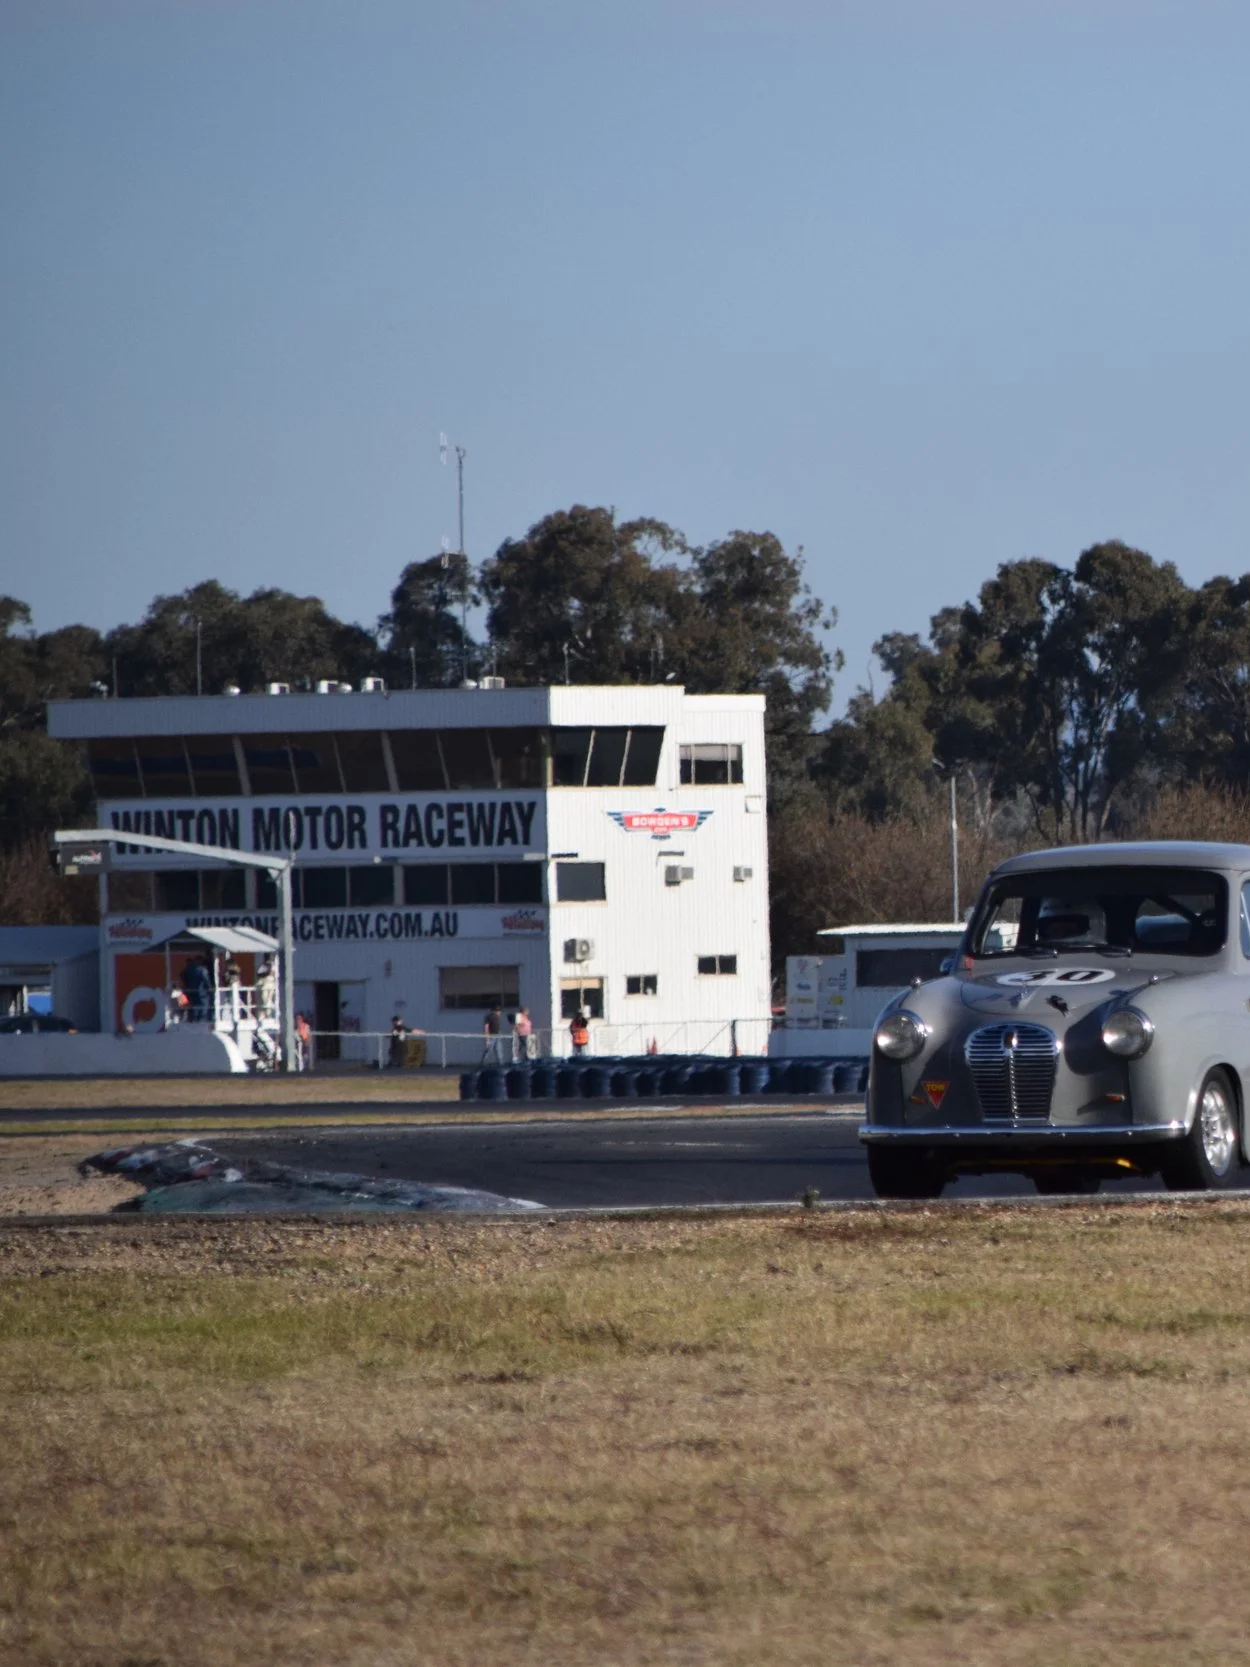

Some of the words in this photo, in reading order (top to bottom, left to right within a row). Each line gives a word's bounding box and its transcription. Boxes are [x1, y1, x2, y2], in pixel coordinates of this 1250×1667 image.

[111, 808, 240, 855] WINTON
[252, 805, 367, 851] MOTOR
[380, 801, 537, 848] RACEWAY
[1007, 970, 1104, 982] 30
